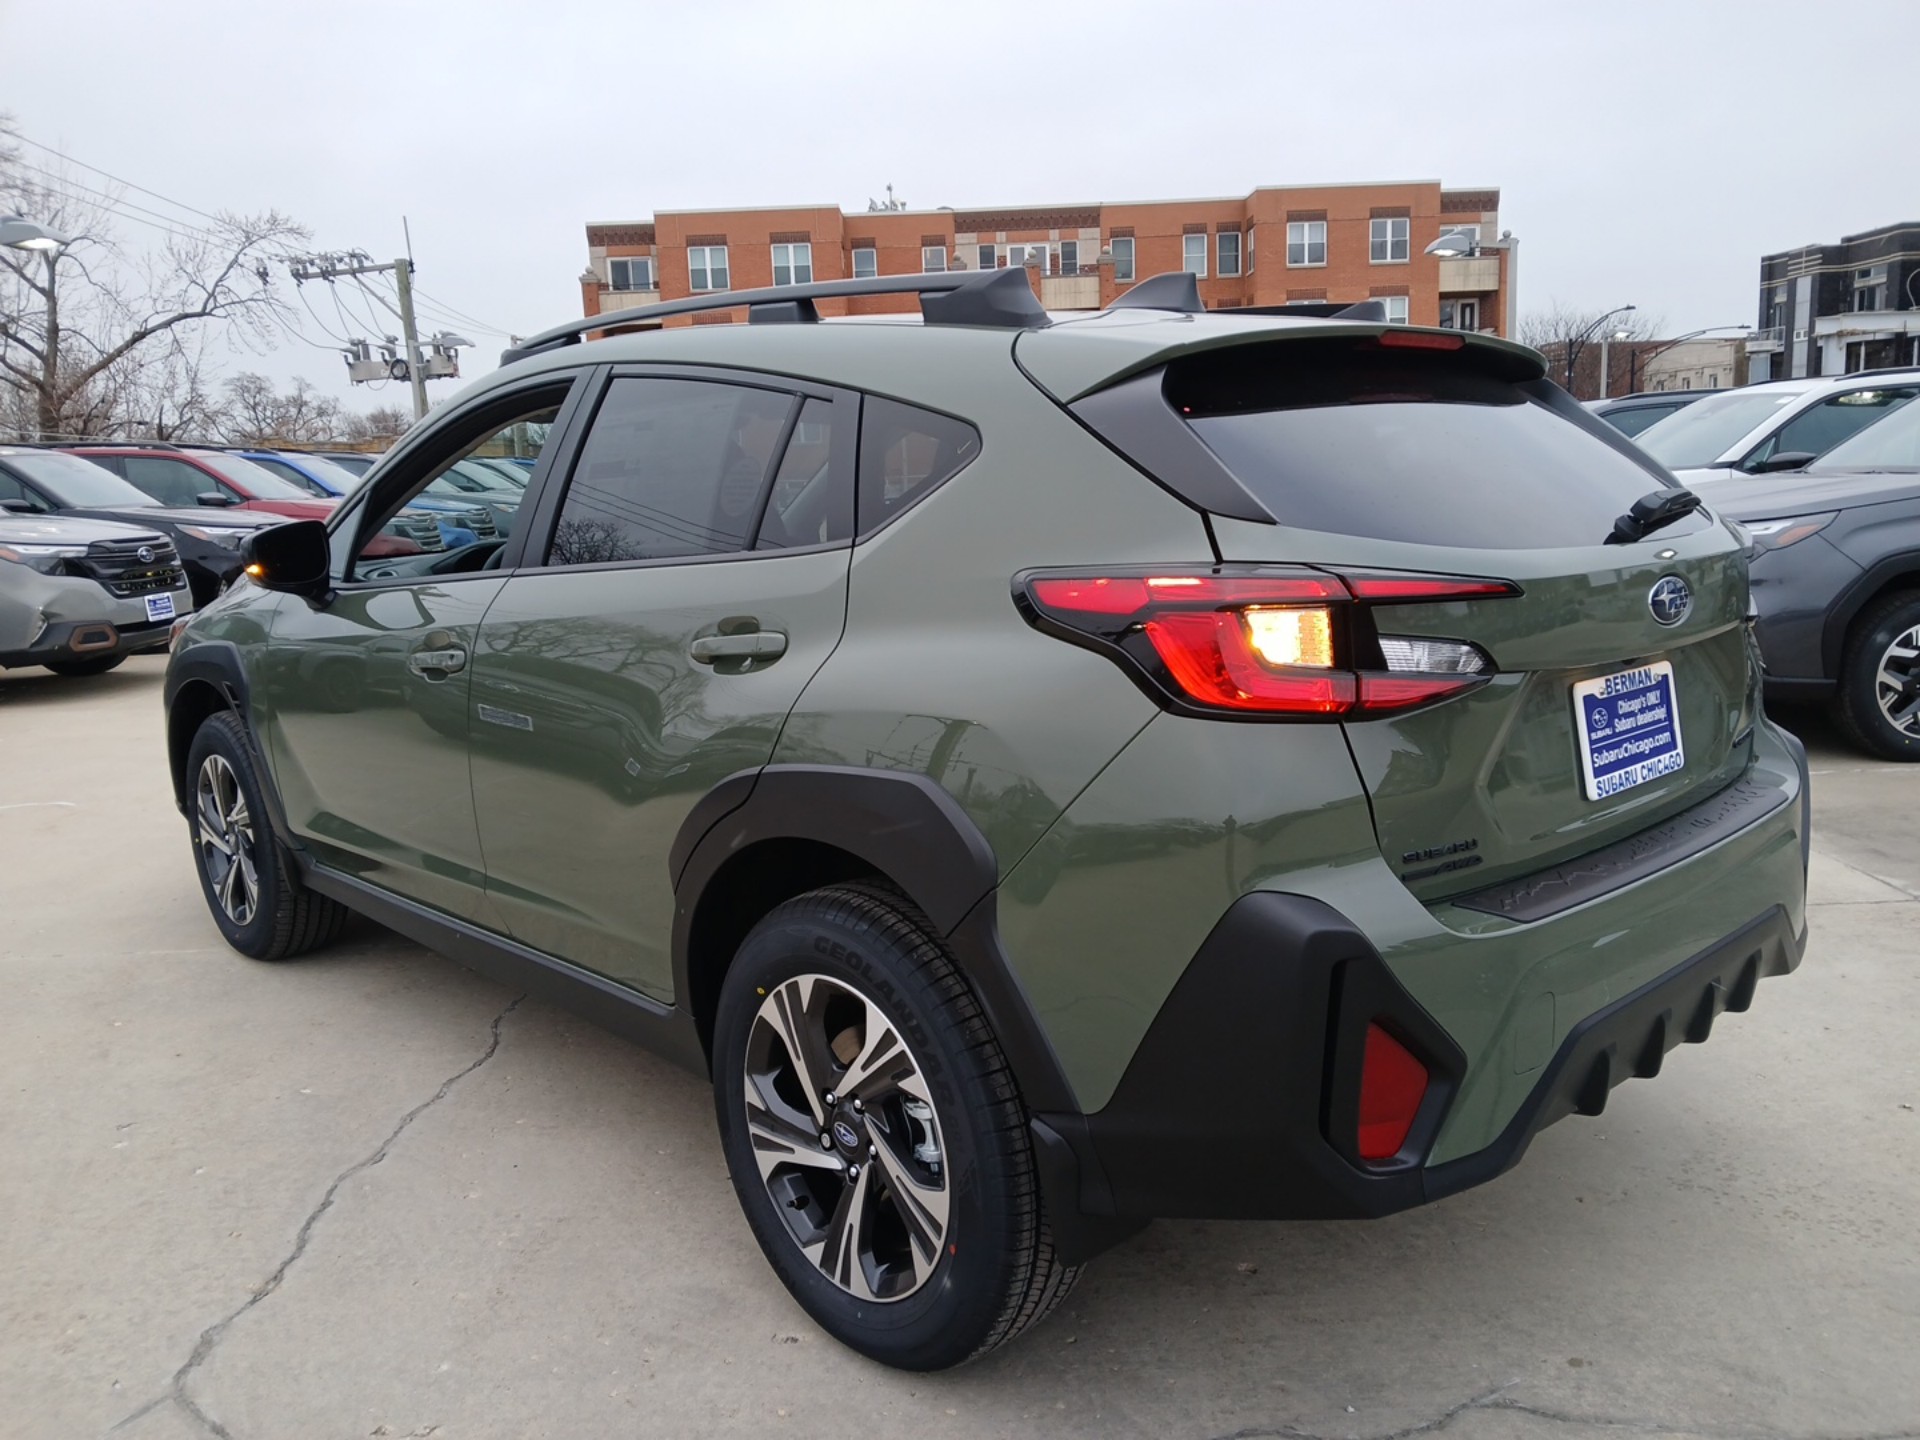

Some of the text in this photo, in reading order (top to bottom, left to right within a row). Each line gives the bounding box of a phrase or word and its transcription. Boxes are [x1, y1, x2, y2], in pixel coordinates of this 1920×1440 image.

[1605, 668, 1651, 695] BERMAN
[1593, 732, 1671, 767] SubaruChicago.com
[1596, 752, 1682, 797] SUBARU CHICAGO
[1403, 838, 1478, 863] SUBARU
[814, 935, 956, 1107] GEOLANDAR
